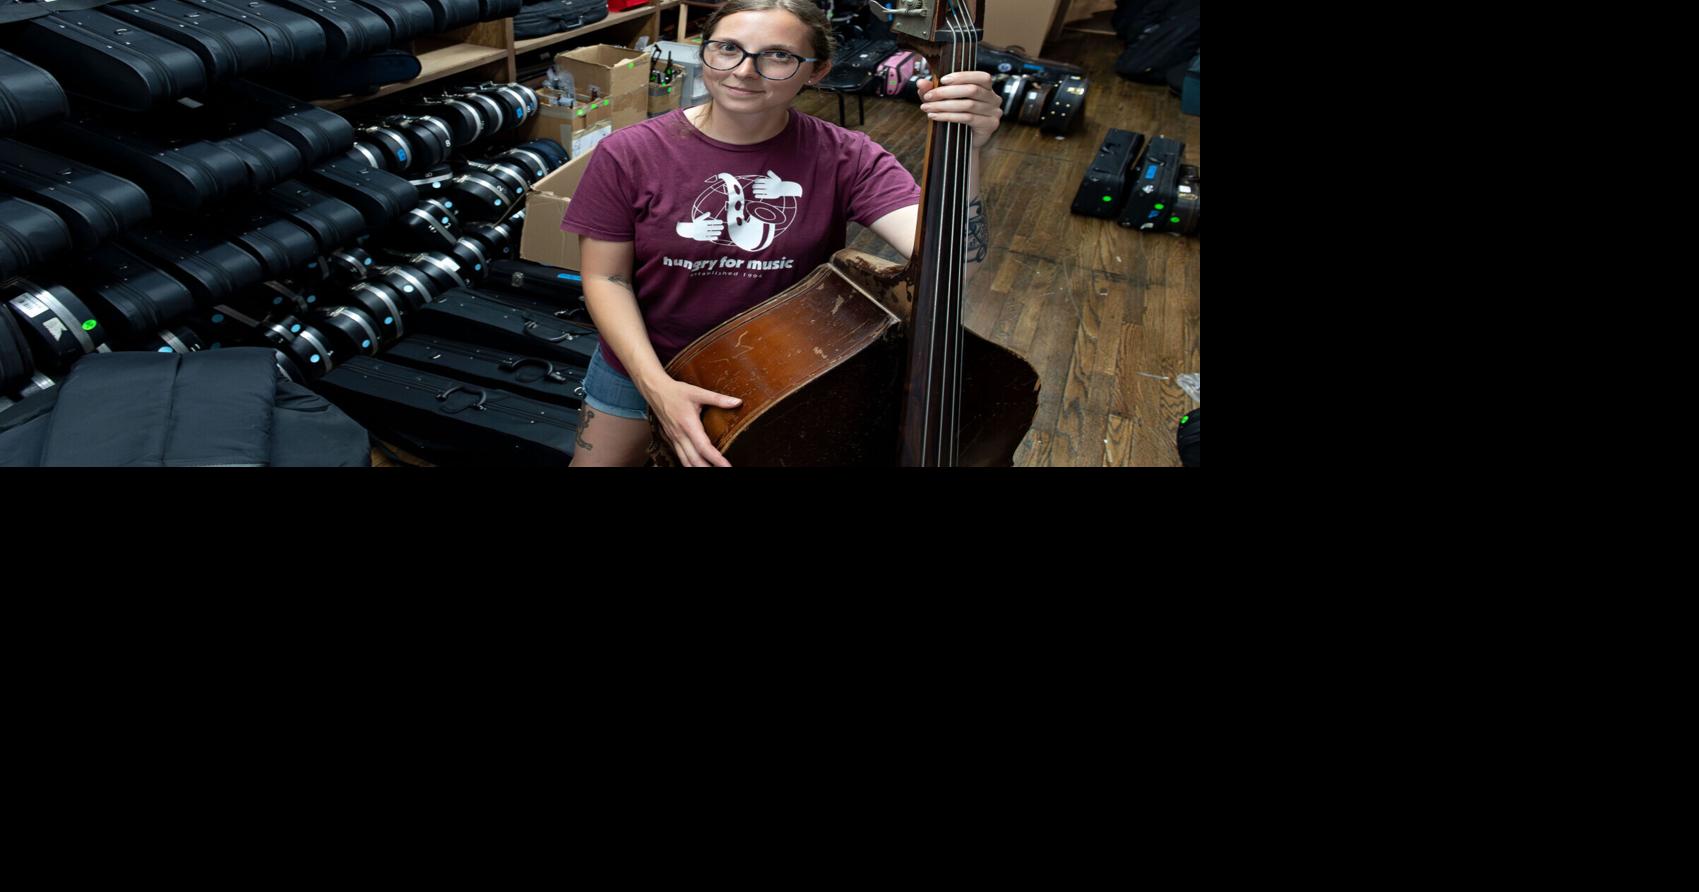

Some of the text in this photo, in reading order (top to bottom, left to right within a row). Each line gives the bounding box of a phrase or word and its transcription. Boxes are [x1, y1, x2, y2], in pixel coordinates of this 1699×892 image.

[663, 256, 794, 271] hungry for music
